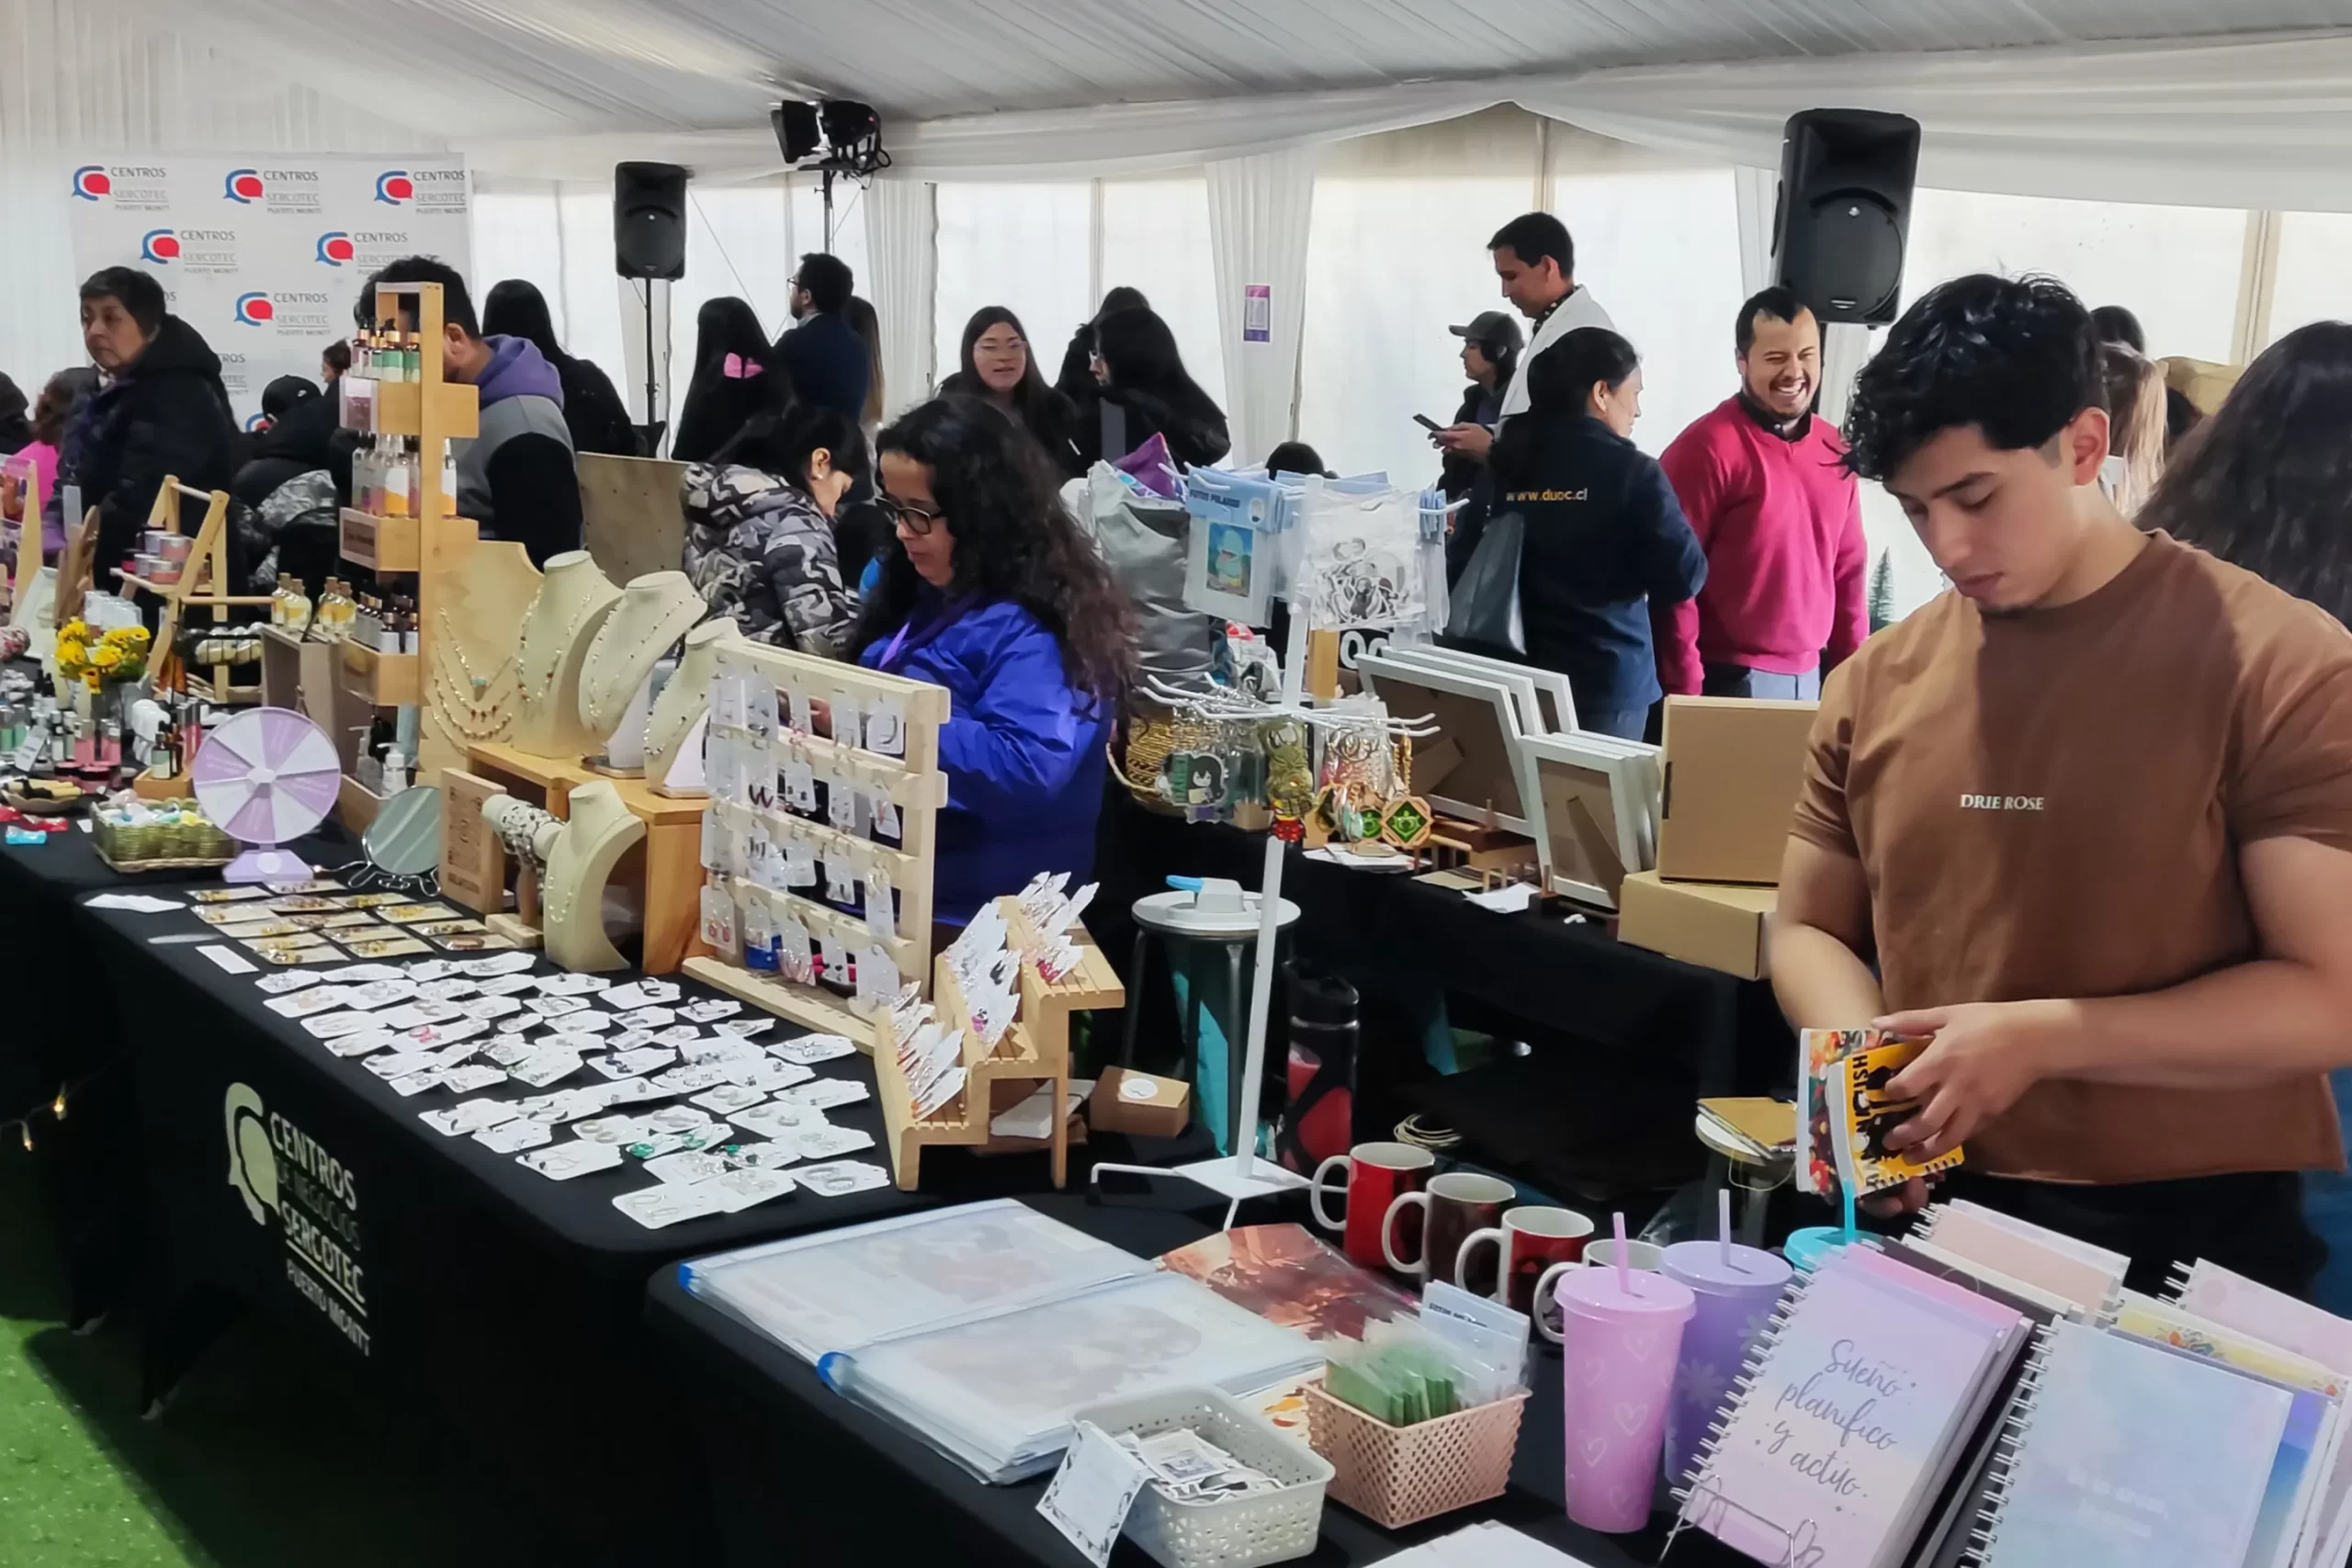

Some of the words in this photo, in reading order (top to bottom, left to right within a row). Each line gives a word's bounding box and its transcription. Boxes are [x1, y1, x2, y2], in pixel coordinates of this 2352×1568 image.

[110, 166, 167, 178] CENTROS
[263, 170, 320, 182] CENTROS
[413, 170, 466, 181] CENTROS
[180, 230, 236, 242] CENTROS
[354, 231, 409, 243] CENTROS
[274, 292, 329, 304] CENTROS
[1506, 487, 1589, 502] www.duoc.cl
[1959, 794, 2002, 809] DRIE
[2003, 795, 2045, 810] ROSE
[269, 1111, 357, 1212] CENTROS
[280, 1200, 367, 1305] SERCOTEC
[1773, 1371, 1898, 1450] planifico
[1767, 1419, 1794, 1455] y
